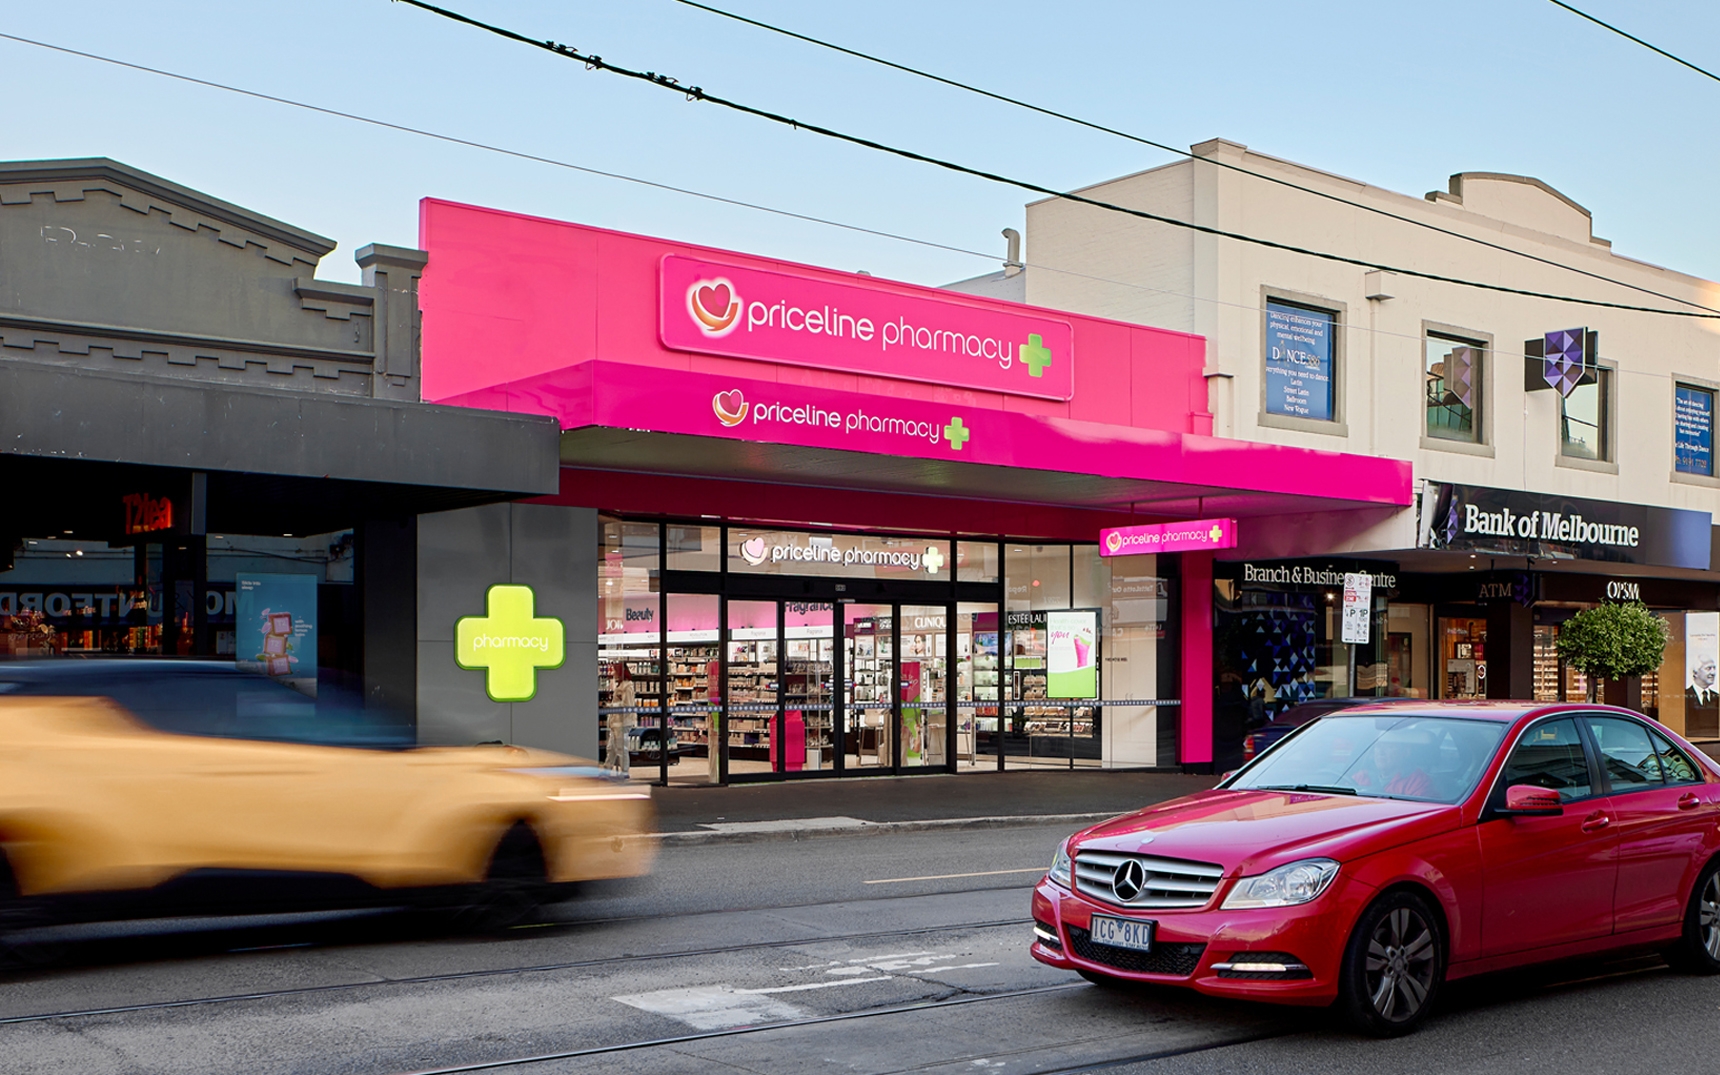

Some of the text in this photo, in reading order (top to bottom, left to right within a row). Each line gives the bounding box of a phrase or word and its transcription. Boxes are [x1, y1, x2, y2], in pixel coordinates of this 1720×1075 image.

[747, 300, 1012, 369] priceline pharmacy
[1266, 366, 1288, 376] verything
[753, 402, 940, 445] priceline pharmacy
[1464, 503, 1639, 547] Bank of Melbourne
[1122, 530, 1208, 548] priceline pharmacy
[772, 544, 920, 571] priceline pharmacy
[1244, 563, 1290, 583] Branch
[1291, 566, 1302, 583] &
[1303, 566, 1345, 586] Busine
[1358, 569, 1396, 588] ntre
[1478, 582, 1513, 598] ATM
[1607, 580, 1640, 600] OPSM
[626, 607, 653, 622] Beauty
[915, 616, 946, 628] CLINIQU
[473, 633, 549, 652] pharmacy
[1124, 923, 1149, 945] 8KD
